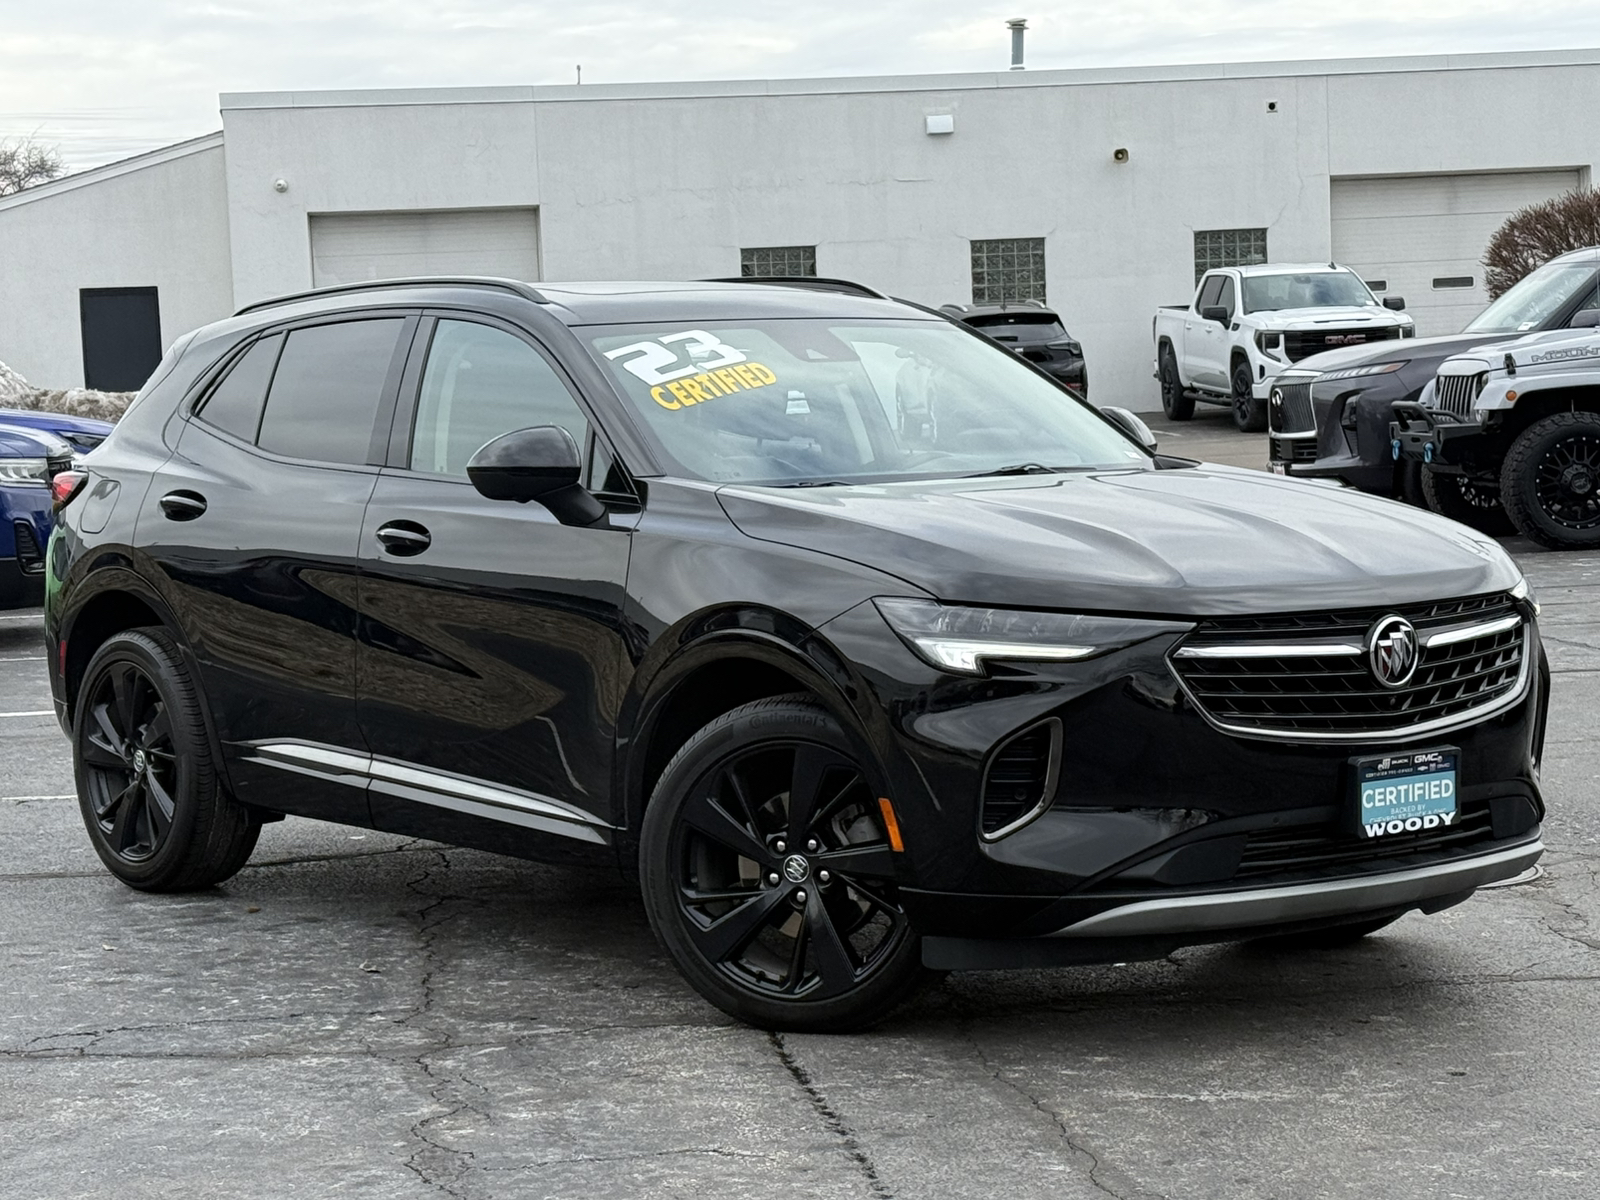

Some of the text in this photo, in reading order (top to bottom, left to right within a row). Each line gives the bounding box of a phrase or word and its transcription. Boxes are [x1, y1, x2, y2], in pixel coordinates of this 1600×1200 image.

[1325, 334, 1366, 345] GMC
[603, 329, 747, 386] 23
[1531, 346, 1600, 363] MOUN
[650, 362, 777, 411] CERTIFIED
[1414, 752, 1439, 764] GMC
[1362, 779, 1453, 808] CERTIFIED
[1390, 805, 1416, 814] BACKED
[1365, 811, 1456, 838] WOODY
